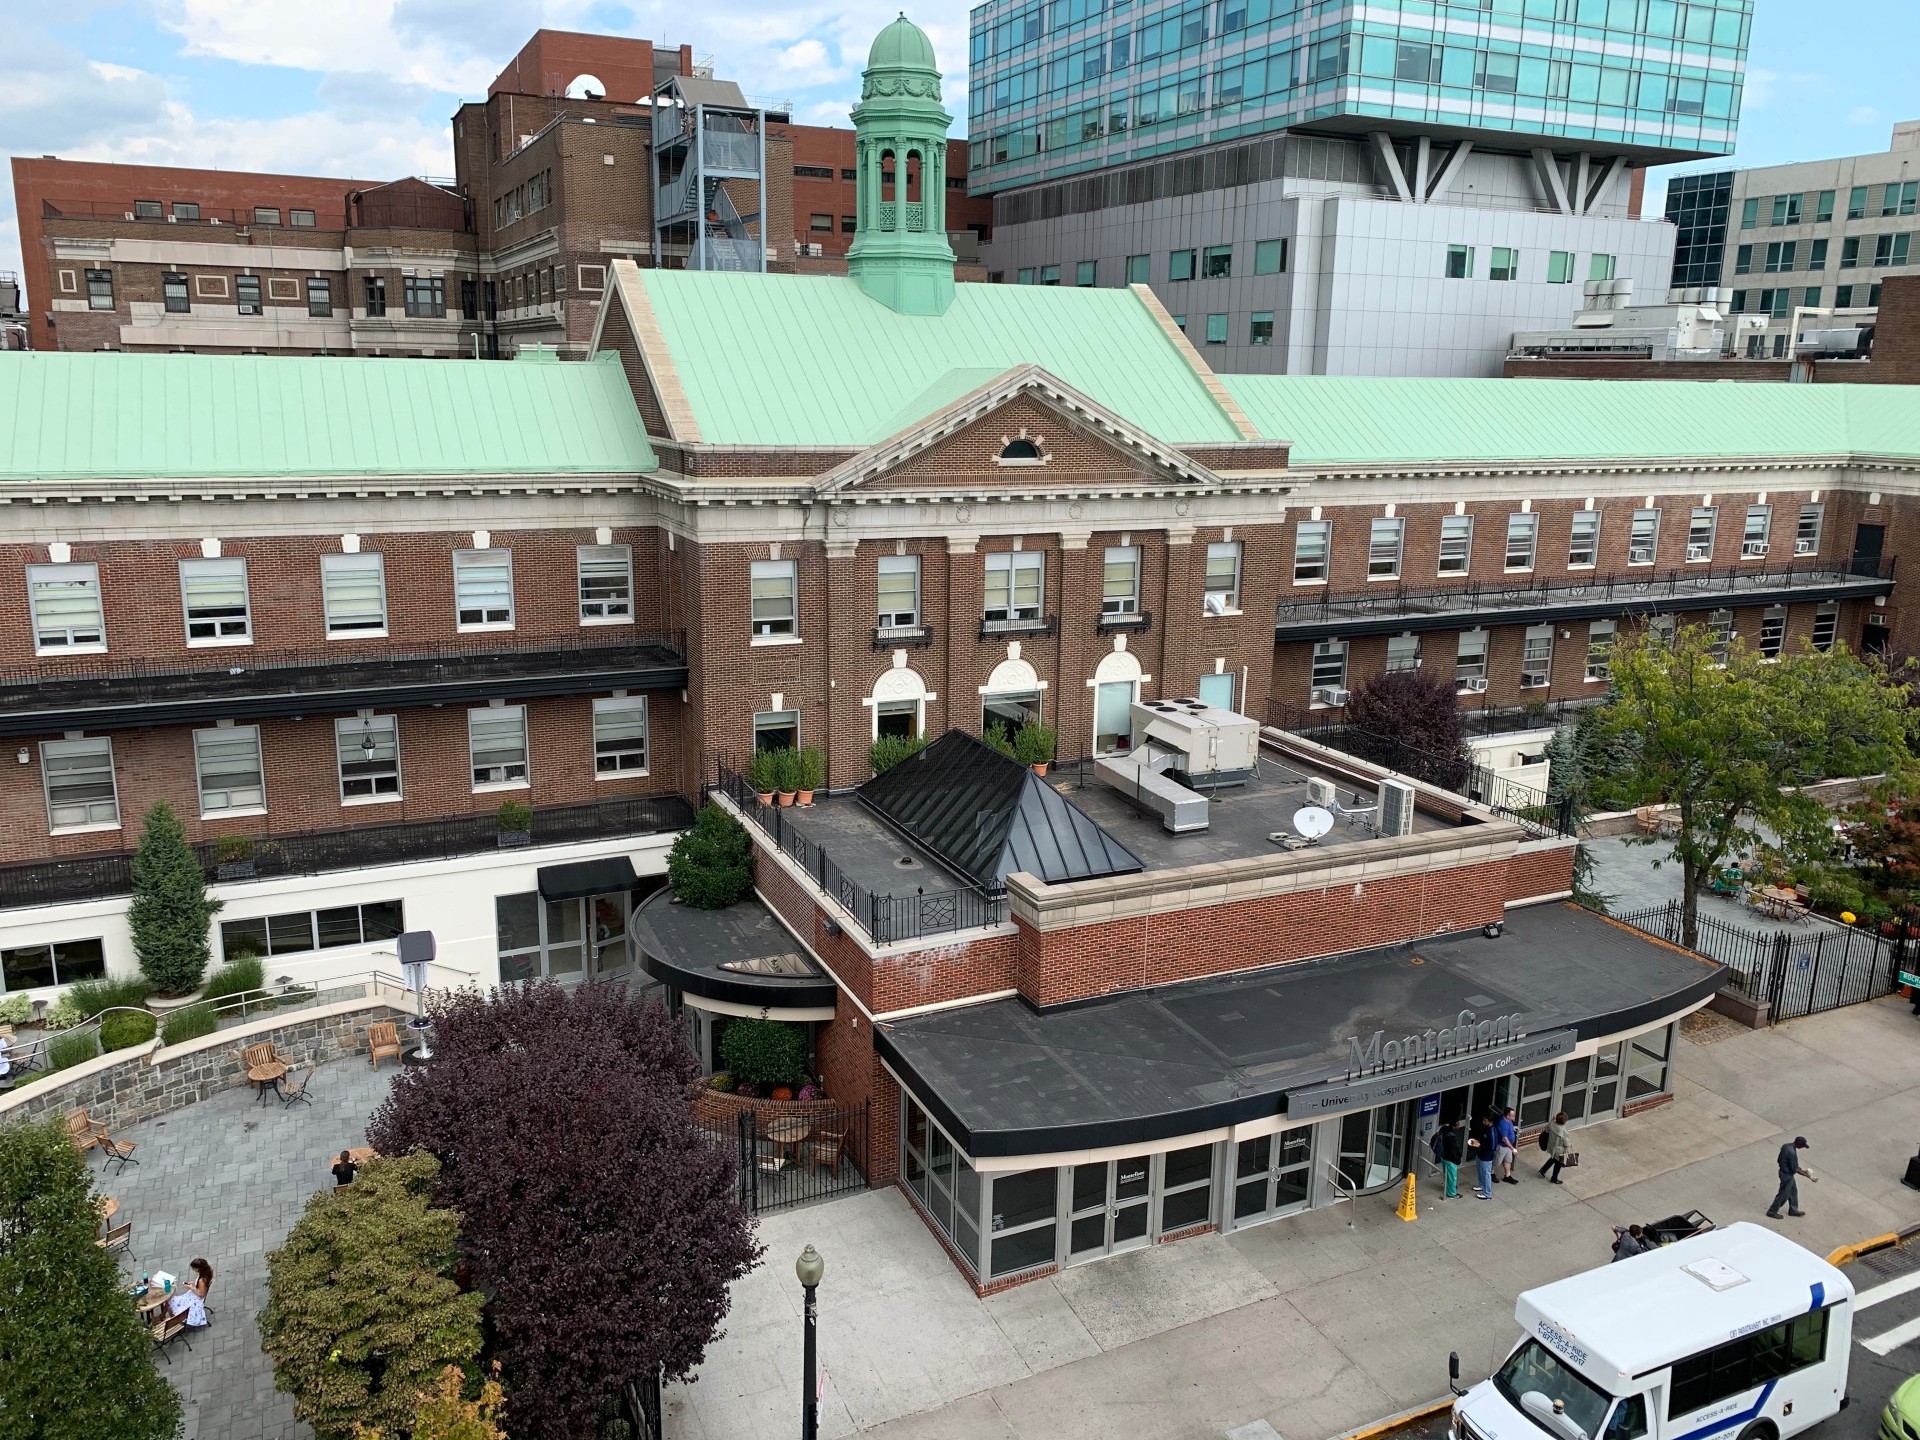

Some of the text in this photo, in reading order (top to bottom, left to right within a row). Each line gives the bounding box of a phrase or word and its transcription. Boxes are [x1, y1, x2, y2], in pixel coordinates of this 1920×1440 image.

[1345, 1009, 1522, 1072] Montefiore
[1300, 1100, 1318, 1112] The
[1374, 1081, 1412, 1098] Hospital
[1415, 1079, 1428, 1089] for
[1430, 1070, 1457, 1084] Albert
[1496, 1055, 1524, 1069] College
[1526, 1050, 1535, 1060] of
[1538, 1320, 1588, 1361] ACCESS-A-RIDE
[1538, 1328, 1585, 1366] 1-877-337-2017
[1696, 1402, 1737, 1423] ACCESS-A-RIDE
